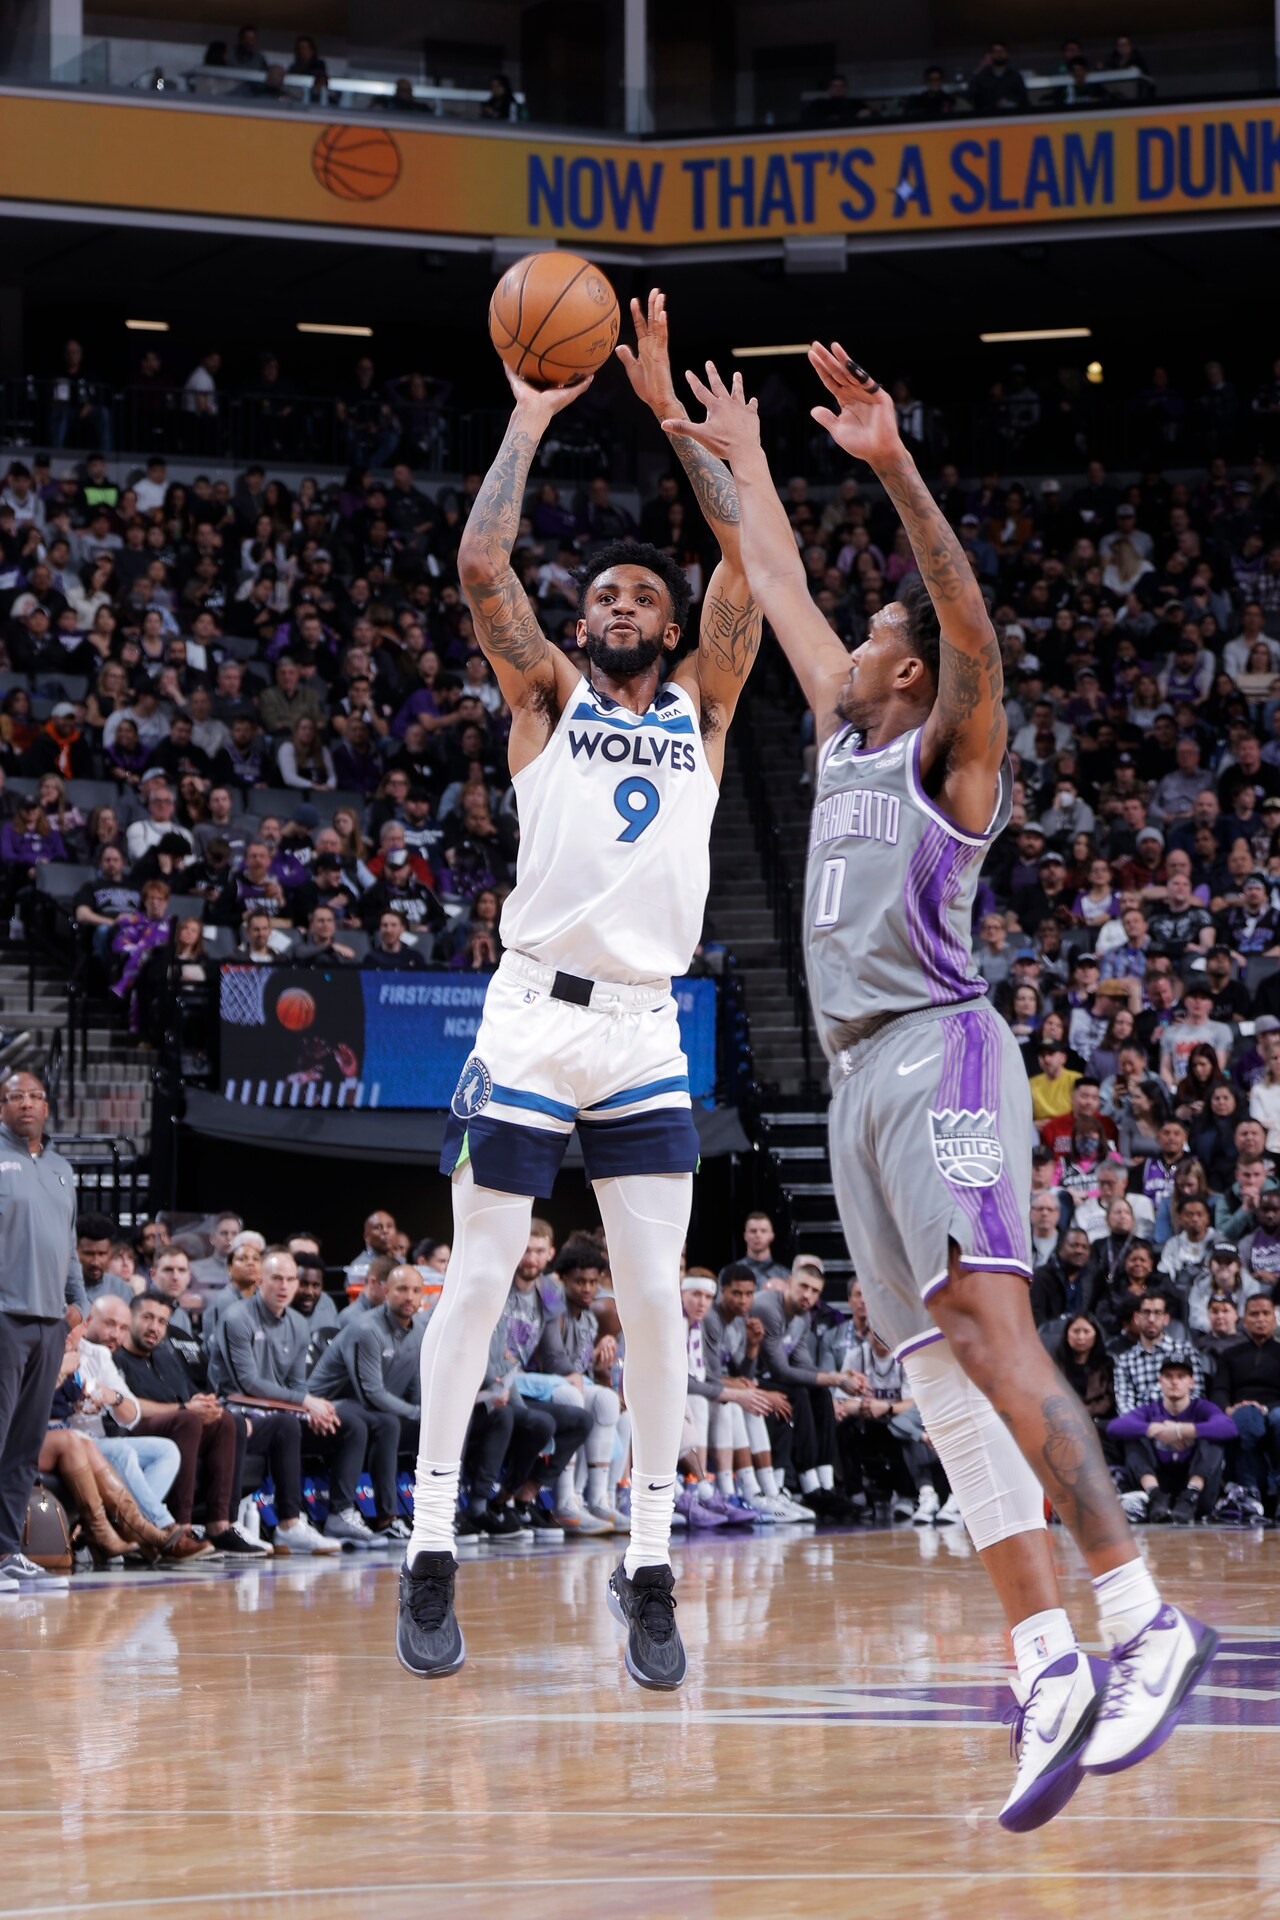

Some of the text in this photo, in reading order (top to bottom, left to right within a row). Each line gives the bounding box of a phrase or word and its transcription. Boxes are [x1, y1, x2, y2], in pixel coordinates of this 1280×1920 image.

[527, 119, 1280, 233] NOW THAT'S A SLAM DUNK
[658, 708, 682, 720] URA
[568, 730, 696, 773] WOLVES
[613, 775, 661, 844] 9
[813, 856, 847, 929] 0
[935, 1140, 1001, 1158] KINGS
